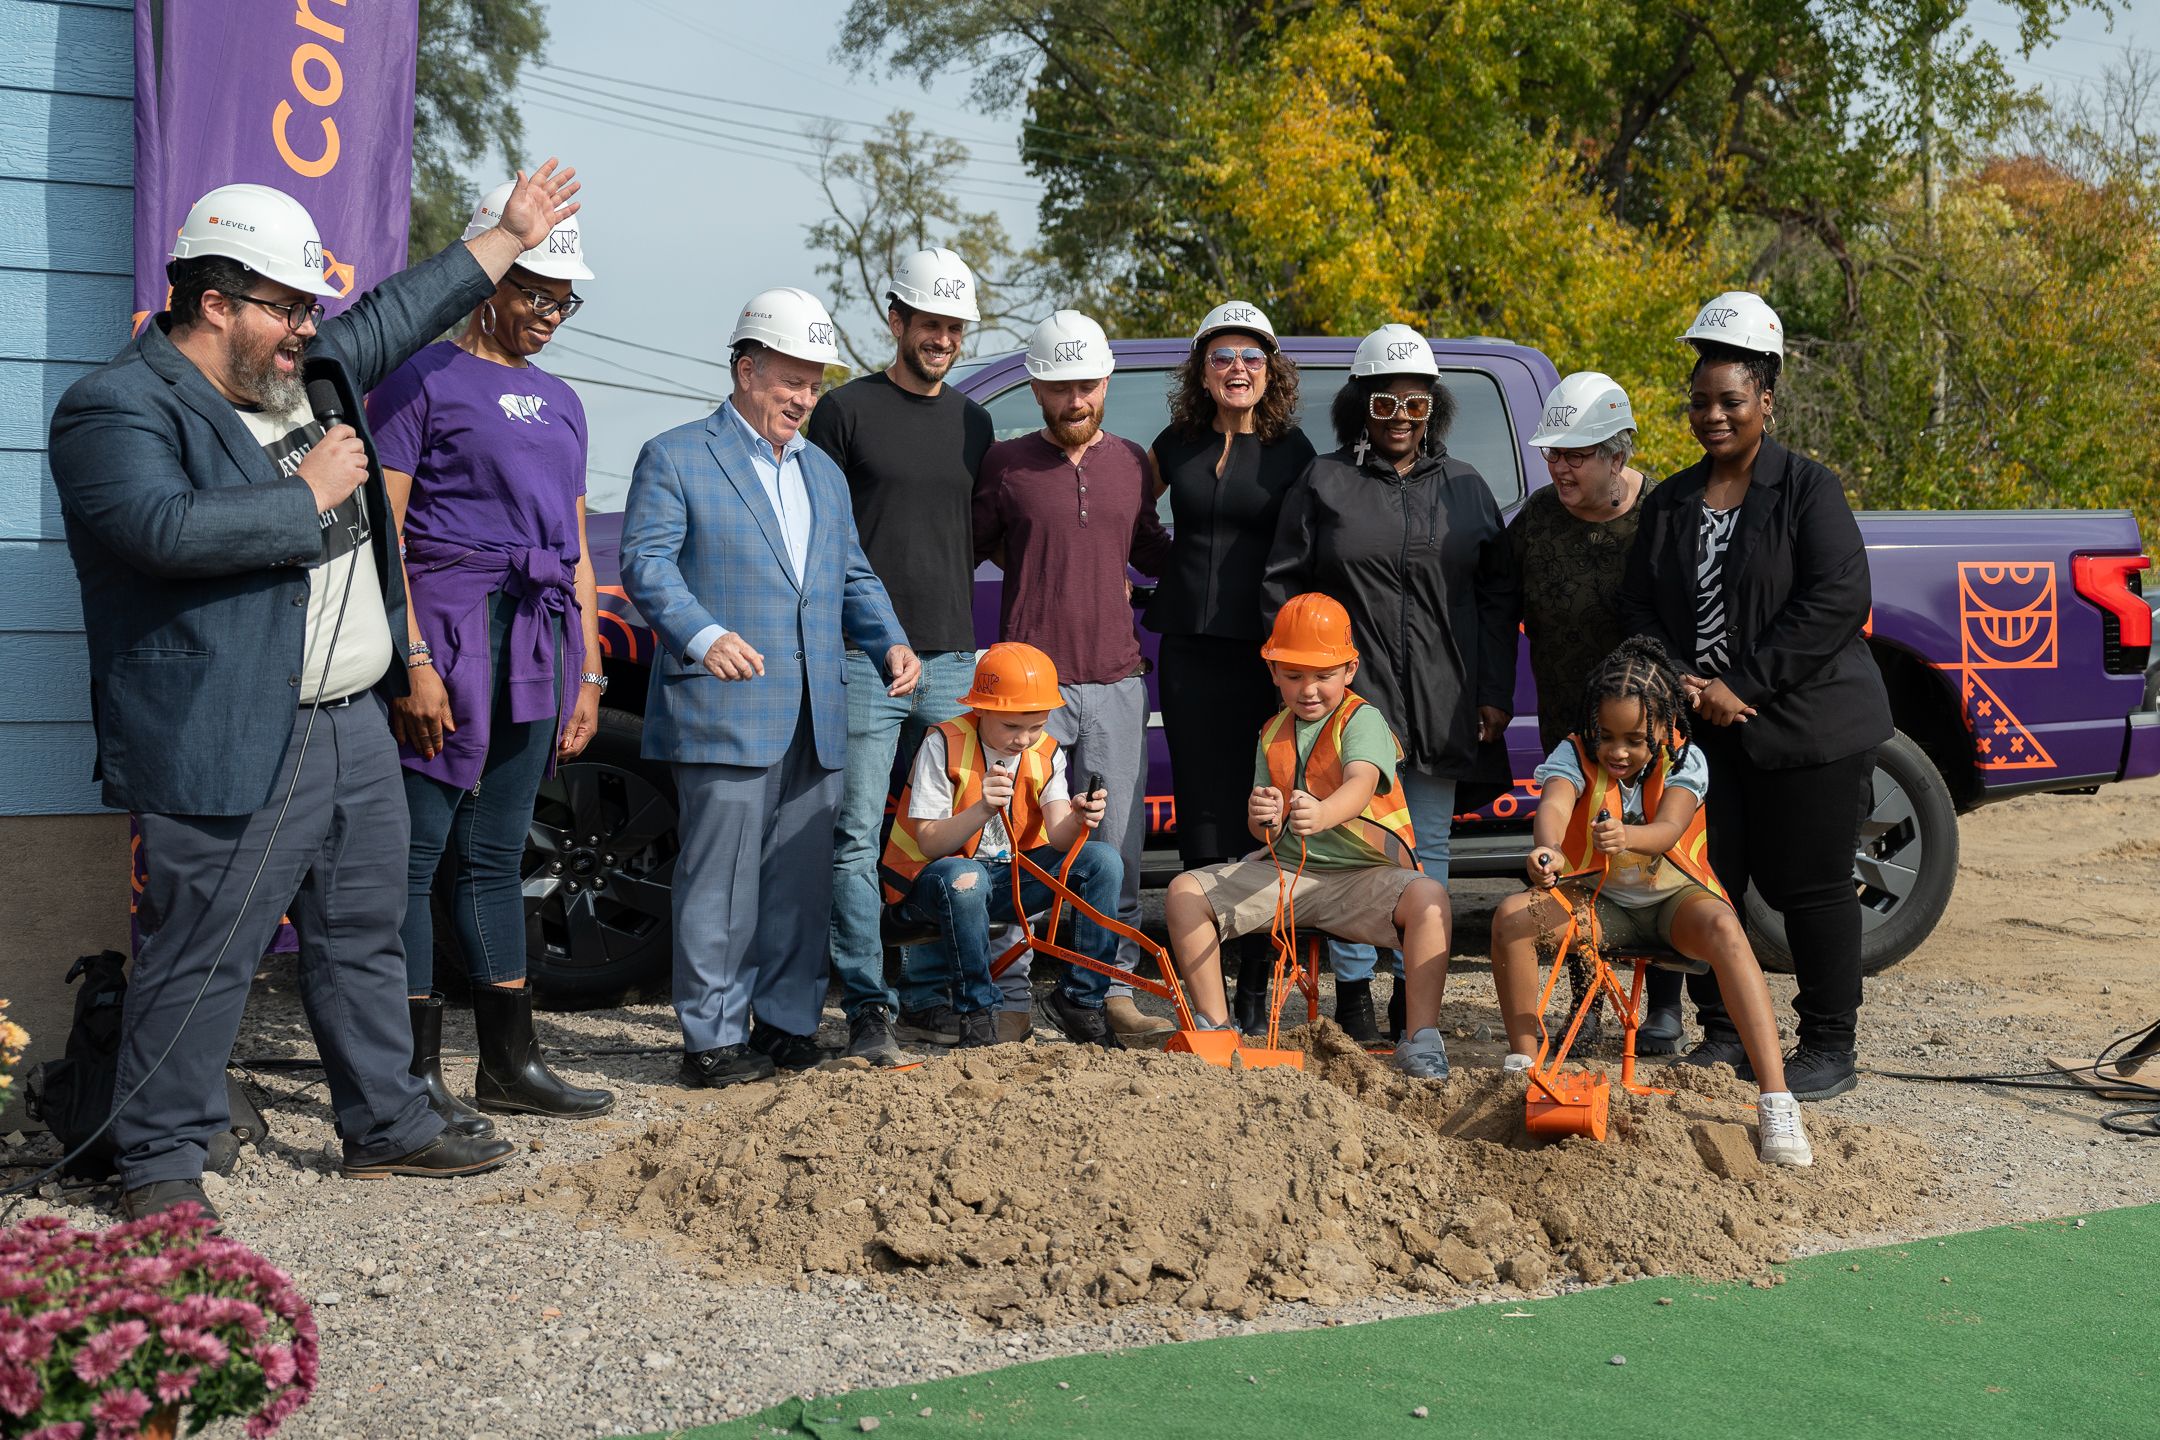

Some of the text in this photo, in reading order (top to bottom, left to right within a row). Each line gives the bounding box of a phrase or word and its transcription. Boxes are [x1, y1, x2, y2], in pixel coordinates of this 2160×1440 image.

[1060, 950, 1090, 968] Community
[1090, 961, 1114, 974] Financial
[1131, 976, 1149, 989] Union
